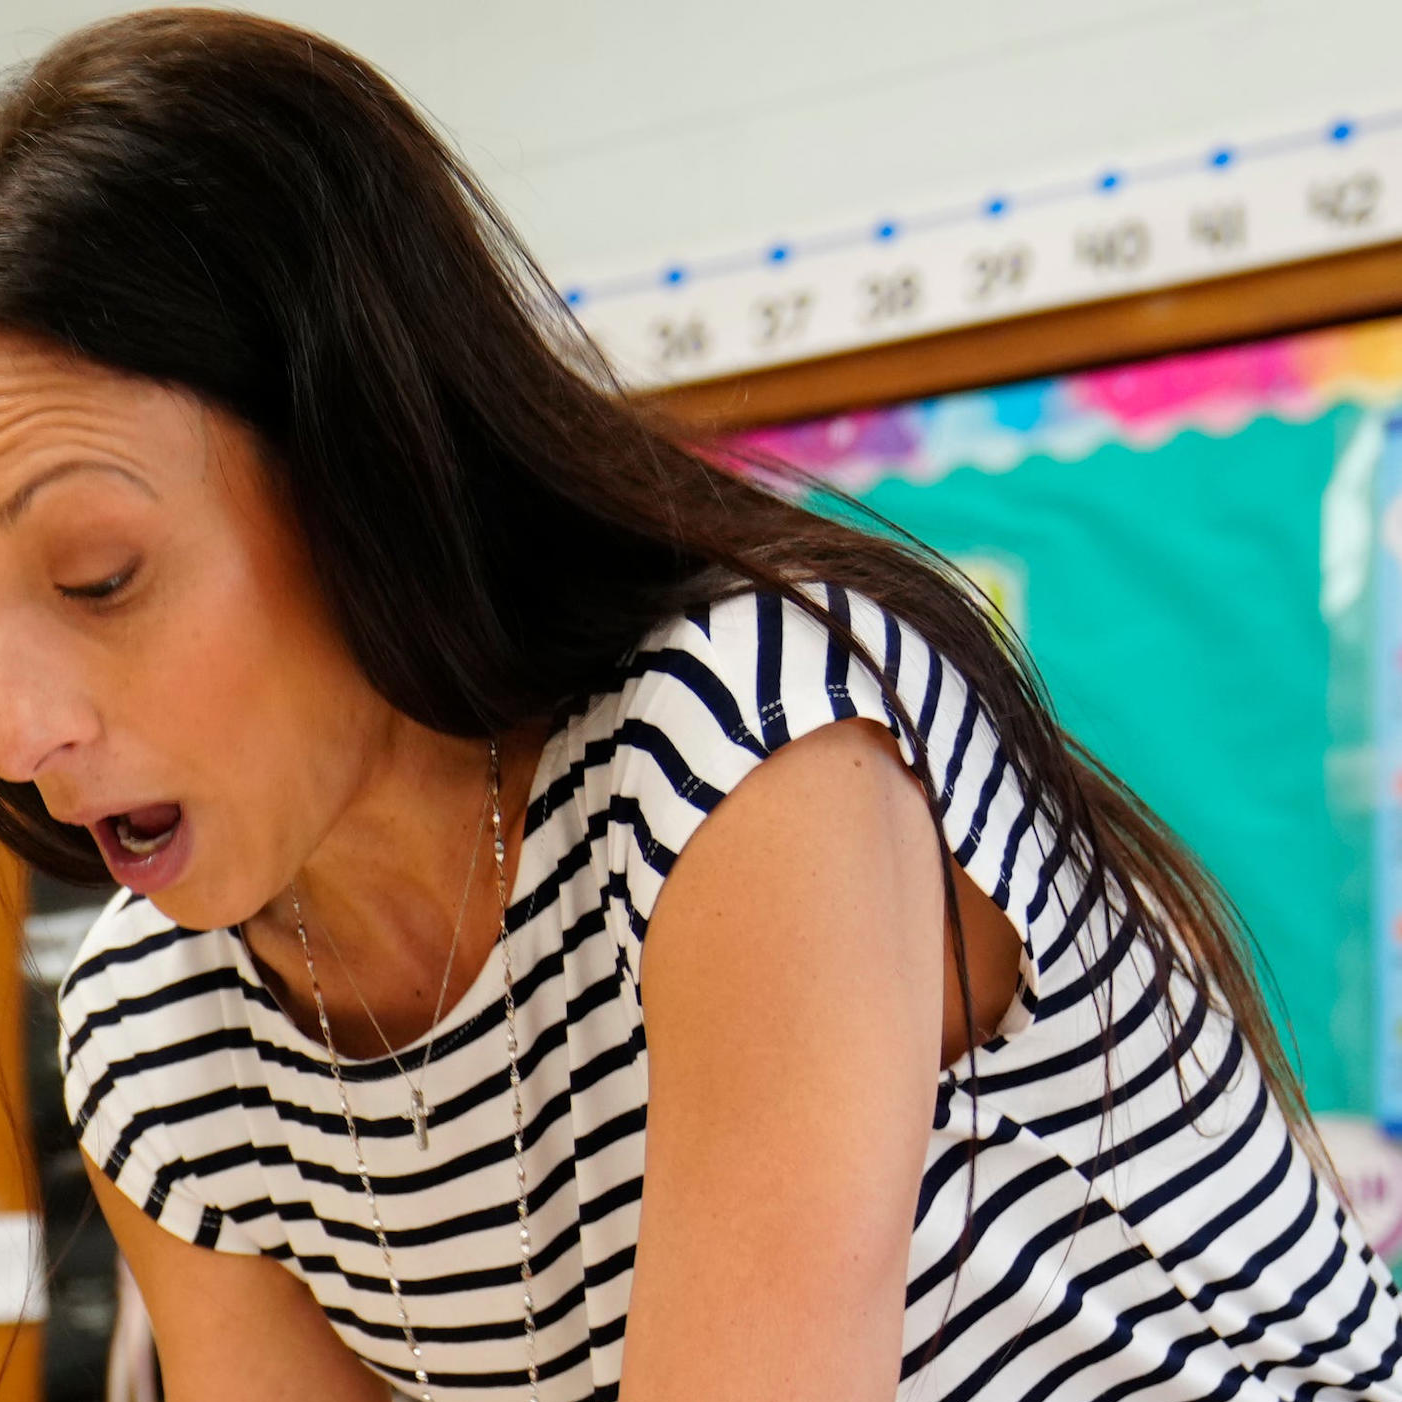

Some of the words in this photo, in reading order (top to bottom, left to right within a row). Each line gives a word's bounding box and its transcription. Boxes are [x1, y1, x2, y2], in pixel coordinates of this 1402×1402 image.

[653, 312, 709, 362] 36
[752, 290, 813, 347] 37
[863, 270, 920, 325] 38
[966, 245, 1032, 300] 39
[1072, 216, 1154, 272] 40
[1189, 196, 1248, 250] 41
[1307, 170, 1384, 227] 42
